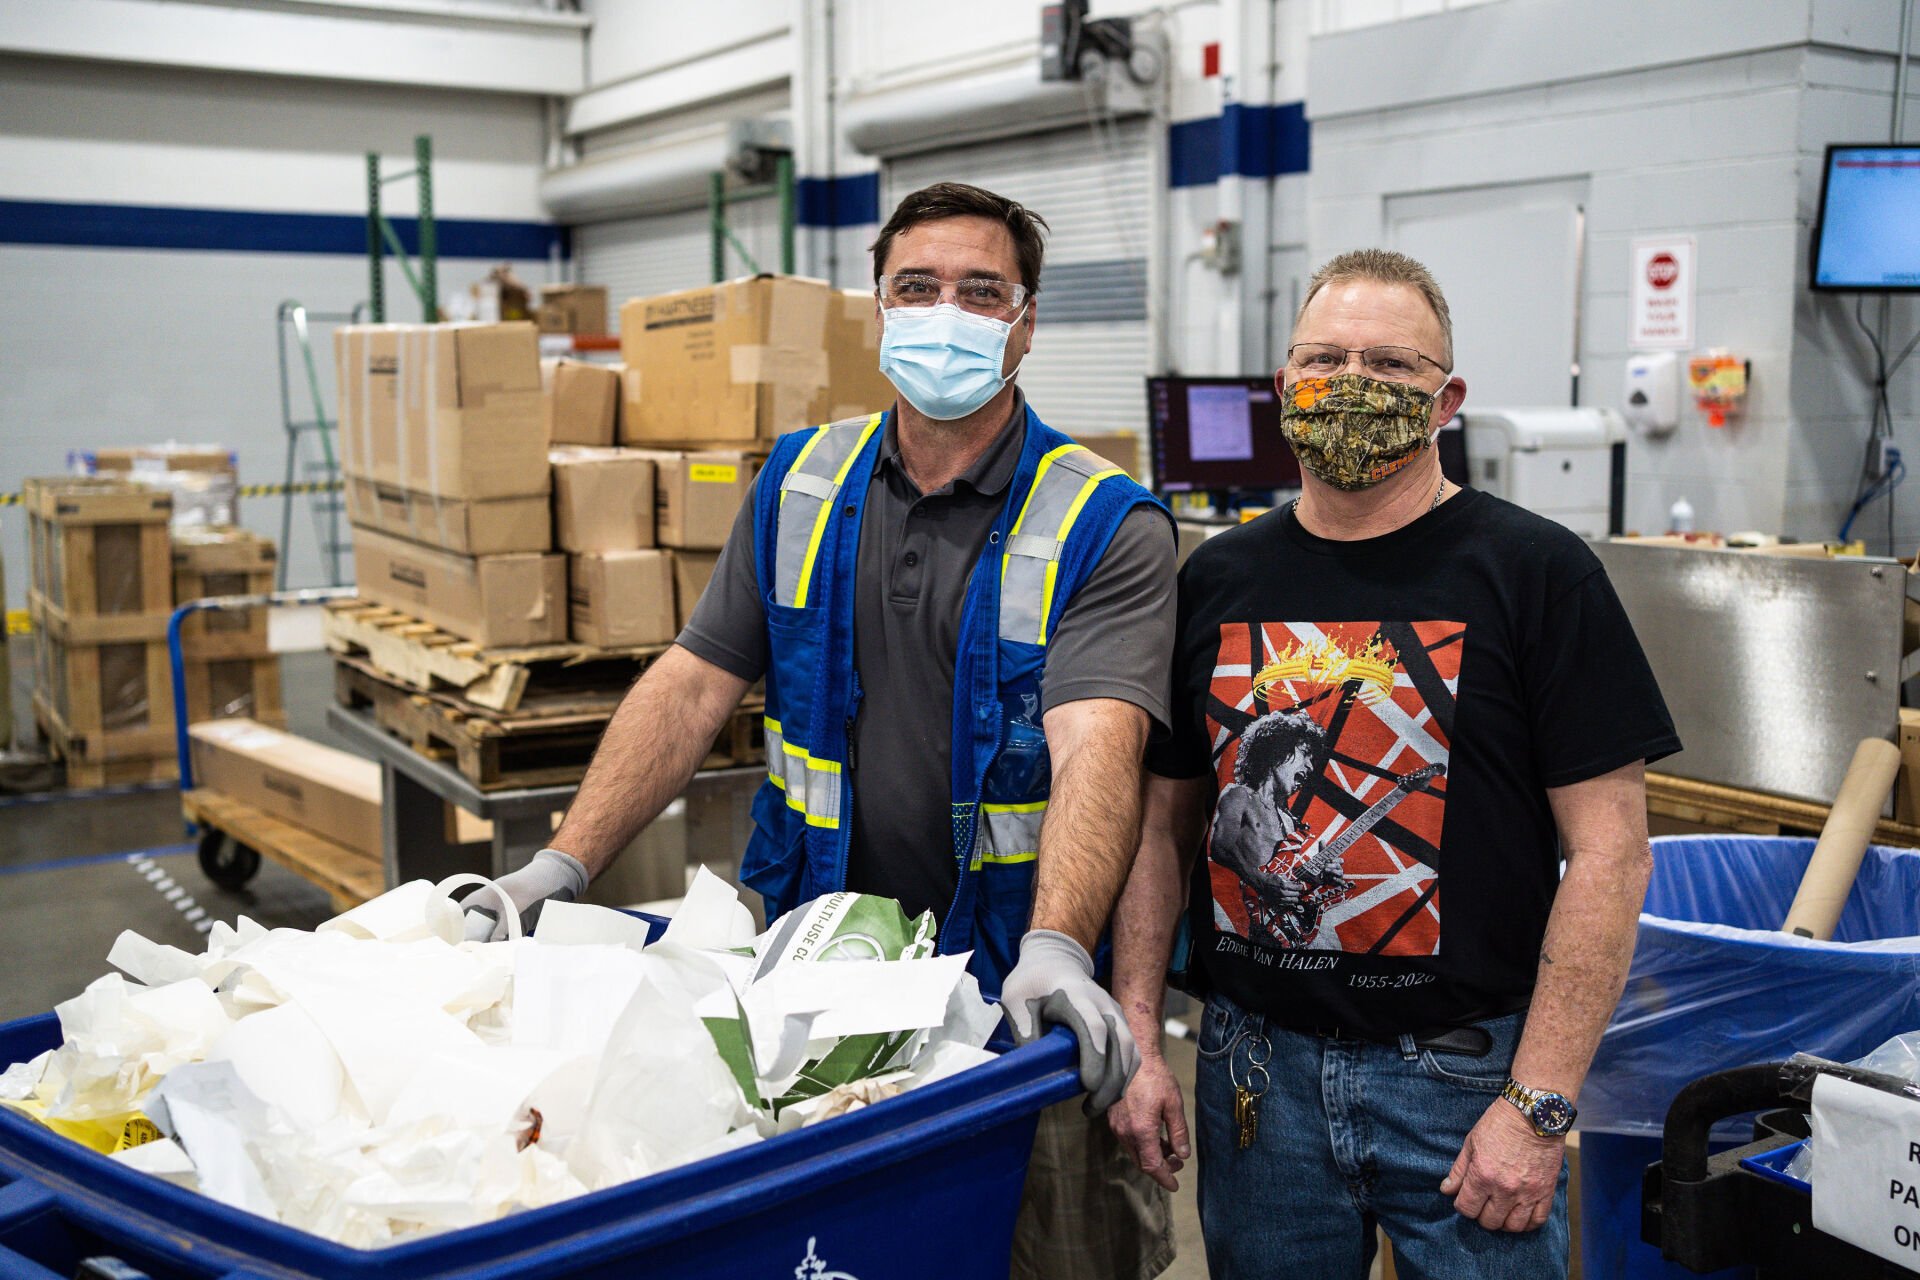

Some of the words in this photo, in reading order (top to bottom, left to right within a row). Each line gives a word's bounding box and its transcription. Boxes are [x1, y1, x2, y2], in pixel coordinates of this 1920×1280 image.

[1647, 263, 1679, 280] STOP
[803, 892, 848, 946] MULTI-USE
[1216, 936, 1248, 957] EDDIE
[1253, 946, 1273, 966] VAN
[1279, 953, 1339, 970] HALEN
[1348, 972, 1436, 988] 1955-2020
[1890, 1179, 1920, 1209] PA
